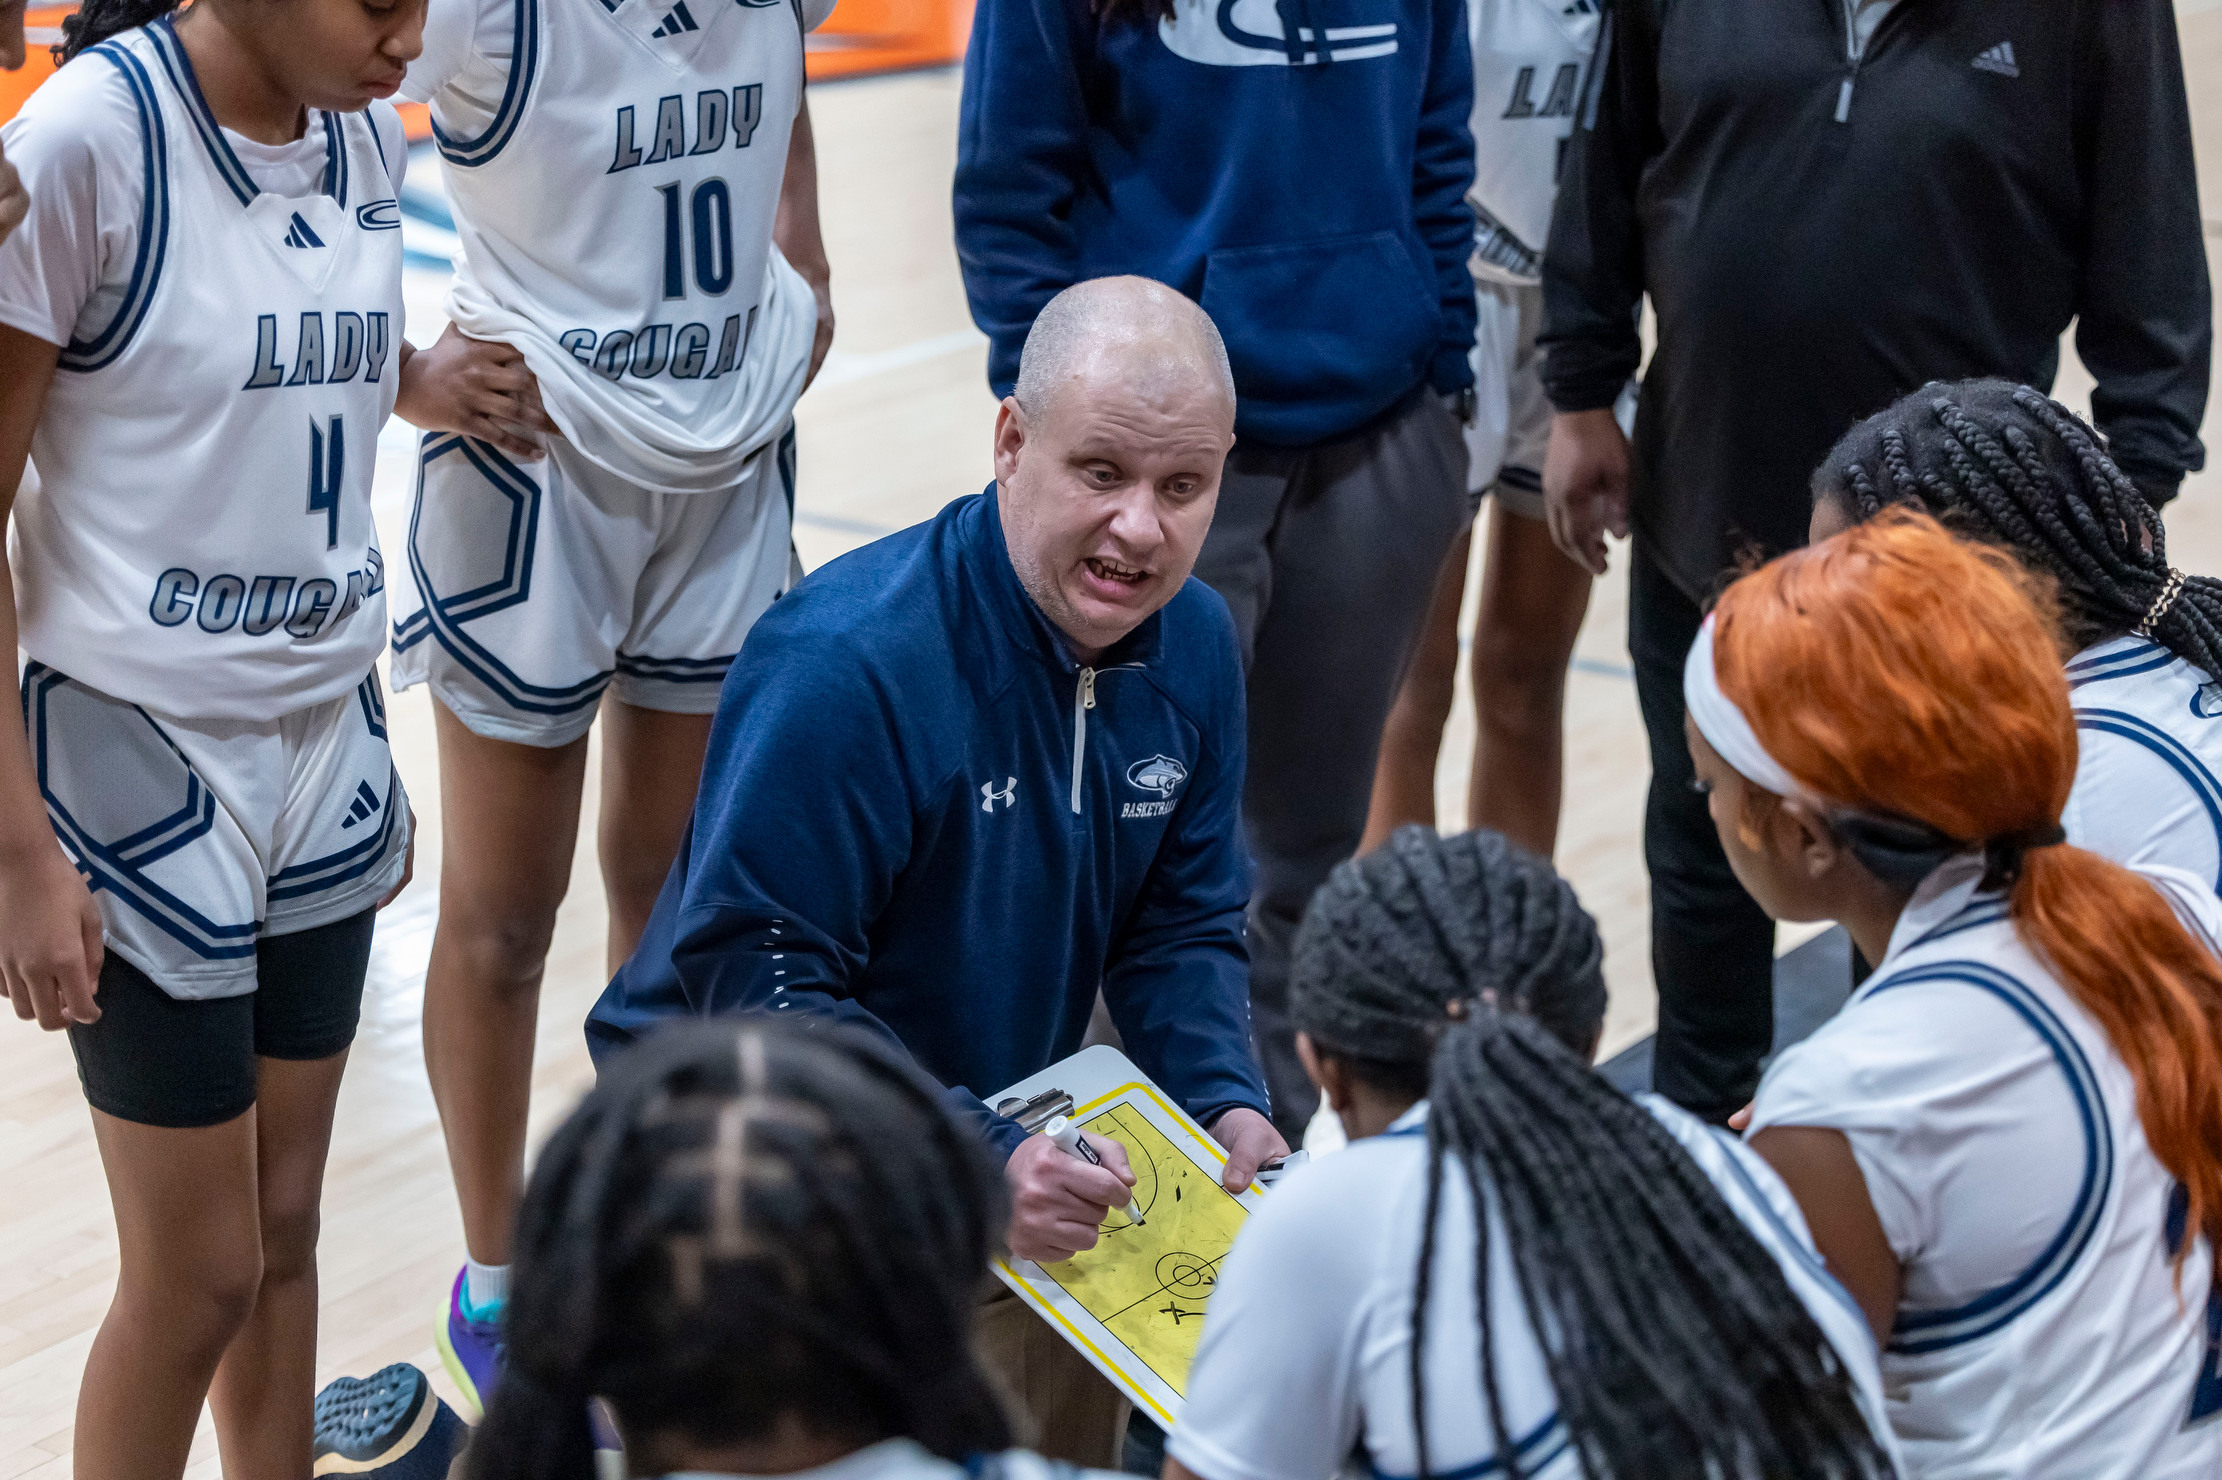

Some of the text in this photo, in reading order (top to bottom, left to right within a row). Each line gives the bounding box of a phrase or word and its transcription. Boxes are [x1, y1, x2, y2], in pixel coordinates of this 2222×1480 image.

[606, 83, 763, 175] LADY
[1501, 64, 1579, 120] LA
[653, 175, 735, 302] 10
[242, 311, 389, 391] LADY
[305, 411, 346, 551] 4
[149, 547, 386, 640] COUGA
